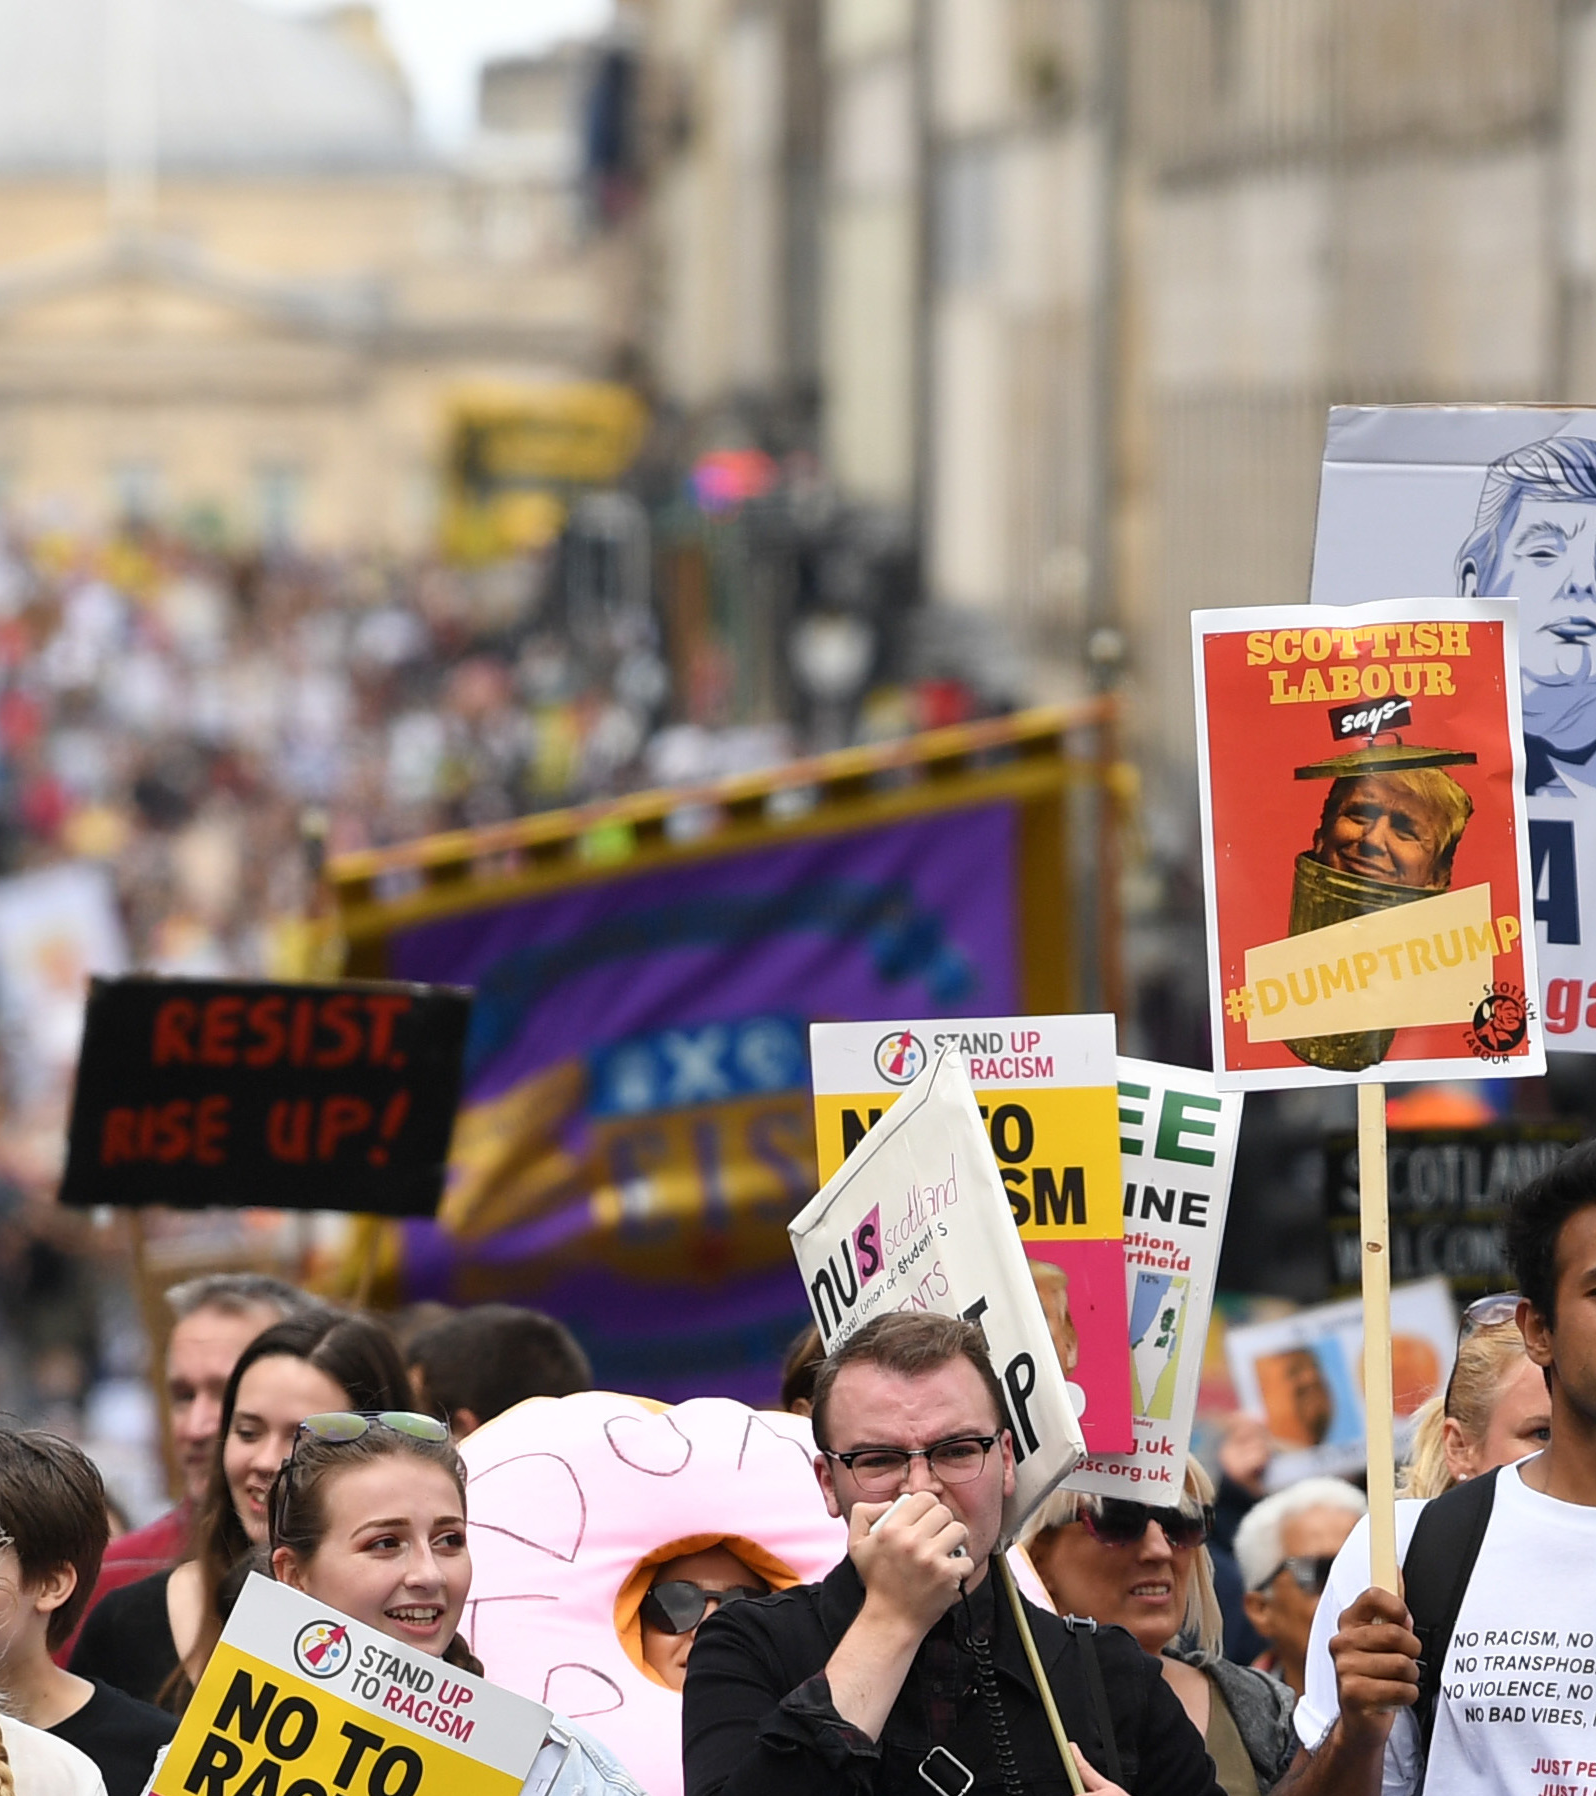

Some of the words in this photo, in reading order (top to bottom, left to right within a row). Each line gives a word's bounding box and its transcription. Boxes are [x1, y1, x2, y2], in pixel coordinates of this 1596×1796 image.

[1247, 623, 1471, 666] SCOTTISH
[1269, 662, 1456, 704] LABOUR
[1340, 701, 1412, 734] says
[1225, 915, 1520, 1024] #DUMPTRUMP
[934, 1033, 1003, 1057] STAND
[1010, 1031, 1041, 1053] UP
[970, 1056, 1054, 1080] RACISM
[102, 1095, 233, 1168] RISE
[266, 1088, 412, 1168] UP!
[1454, 1632, 1479, 1649] NO
[1484, 1630, 1560, 1649] RACISM,
[1566, 1632, 1594, 1649] NO
[359, 1644, 436, 1694] STAND
[437, 1678, 474, 1707] UP
[1454, 1657, 1477, 1674] NO
[350, 1668, 382, 1701] TO
[382, 1687, 475, 1744] RACISM
[1443, 1684, 1464, 1701] NO
[1469, 1681, 1561, 1701] VIOLENCE,
[1566, 1683, 1594, 1701] NO
[212, 1669, 319, 1762] NO
[1465, 1708, 1485, 1724] NO
[1489, 1706, 1526, 1724] BAD
[1531, 1706, 1587, 1729] VIBES,
[1531, 1758, 1572, 1777] JUST
